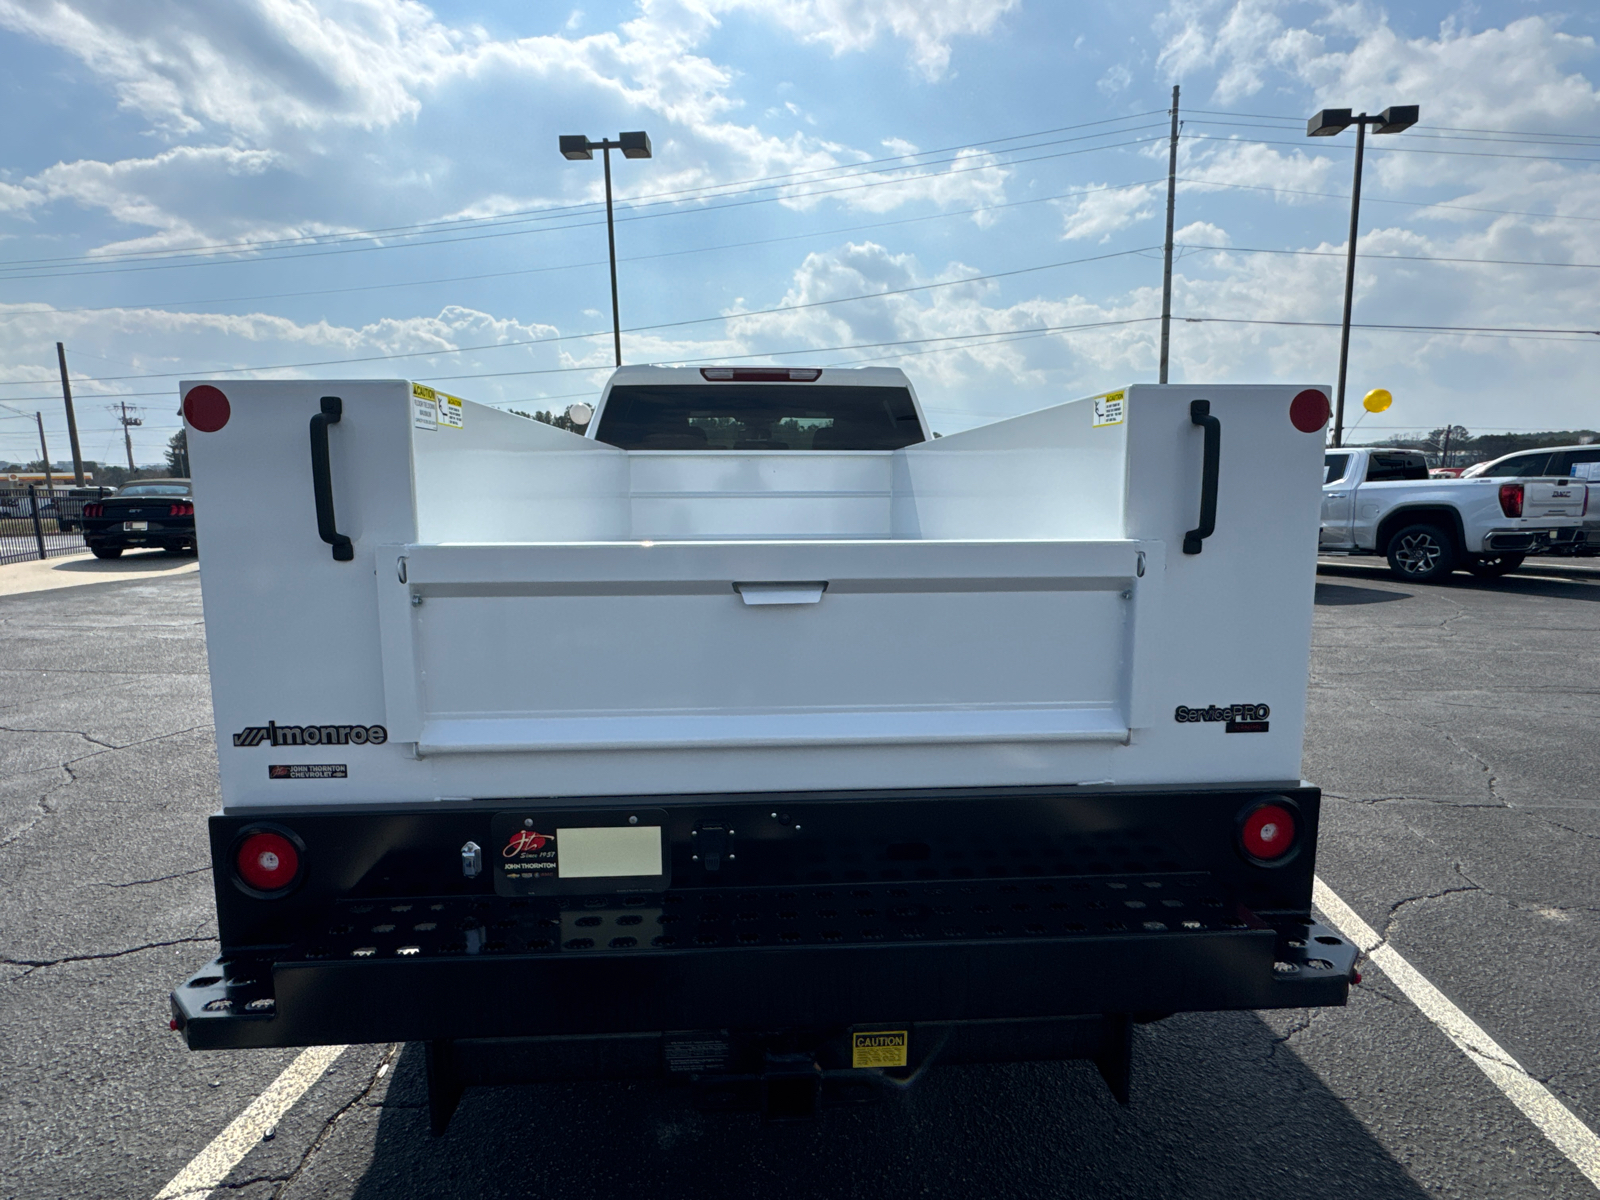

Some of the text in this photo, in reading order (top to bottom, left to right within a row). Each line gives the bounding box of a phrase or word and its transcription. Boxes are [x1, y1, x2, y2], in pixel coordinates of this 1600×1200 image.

[277, 724, 387, 745] monroe
[519, 851, 538, 859] Since
[857, 1036, 903, 1048] CAUTION
